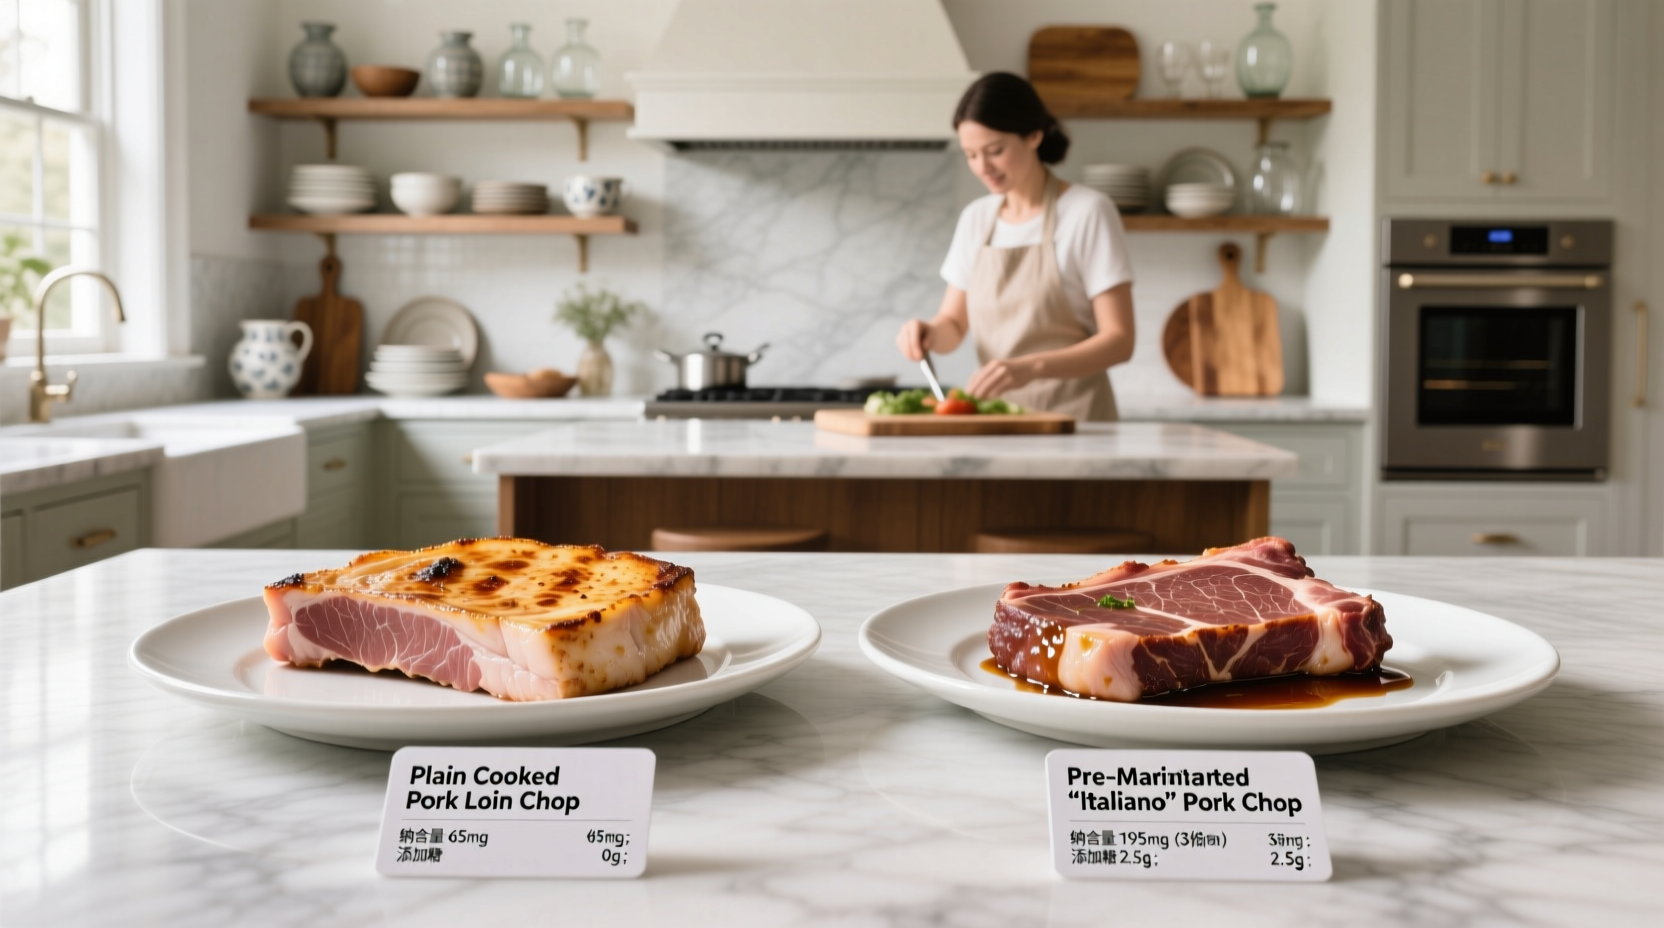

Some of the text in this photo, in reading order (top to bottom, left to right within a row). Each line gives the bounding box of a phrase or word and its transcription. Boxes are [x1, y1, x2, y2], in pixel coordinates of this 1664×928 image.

[409, 765, 561, 786] Plain Cooked
[405, 790, 581, 816] Pork Loin Chop
[1183, 791, 1237, 812] Pork
[1241, 791, 1303, 818] Chop
[447, 829, 489, 848] 65mg
[1118, 831, 1170, 850] 195mg
